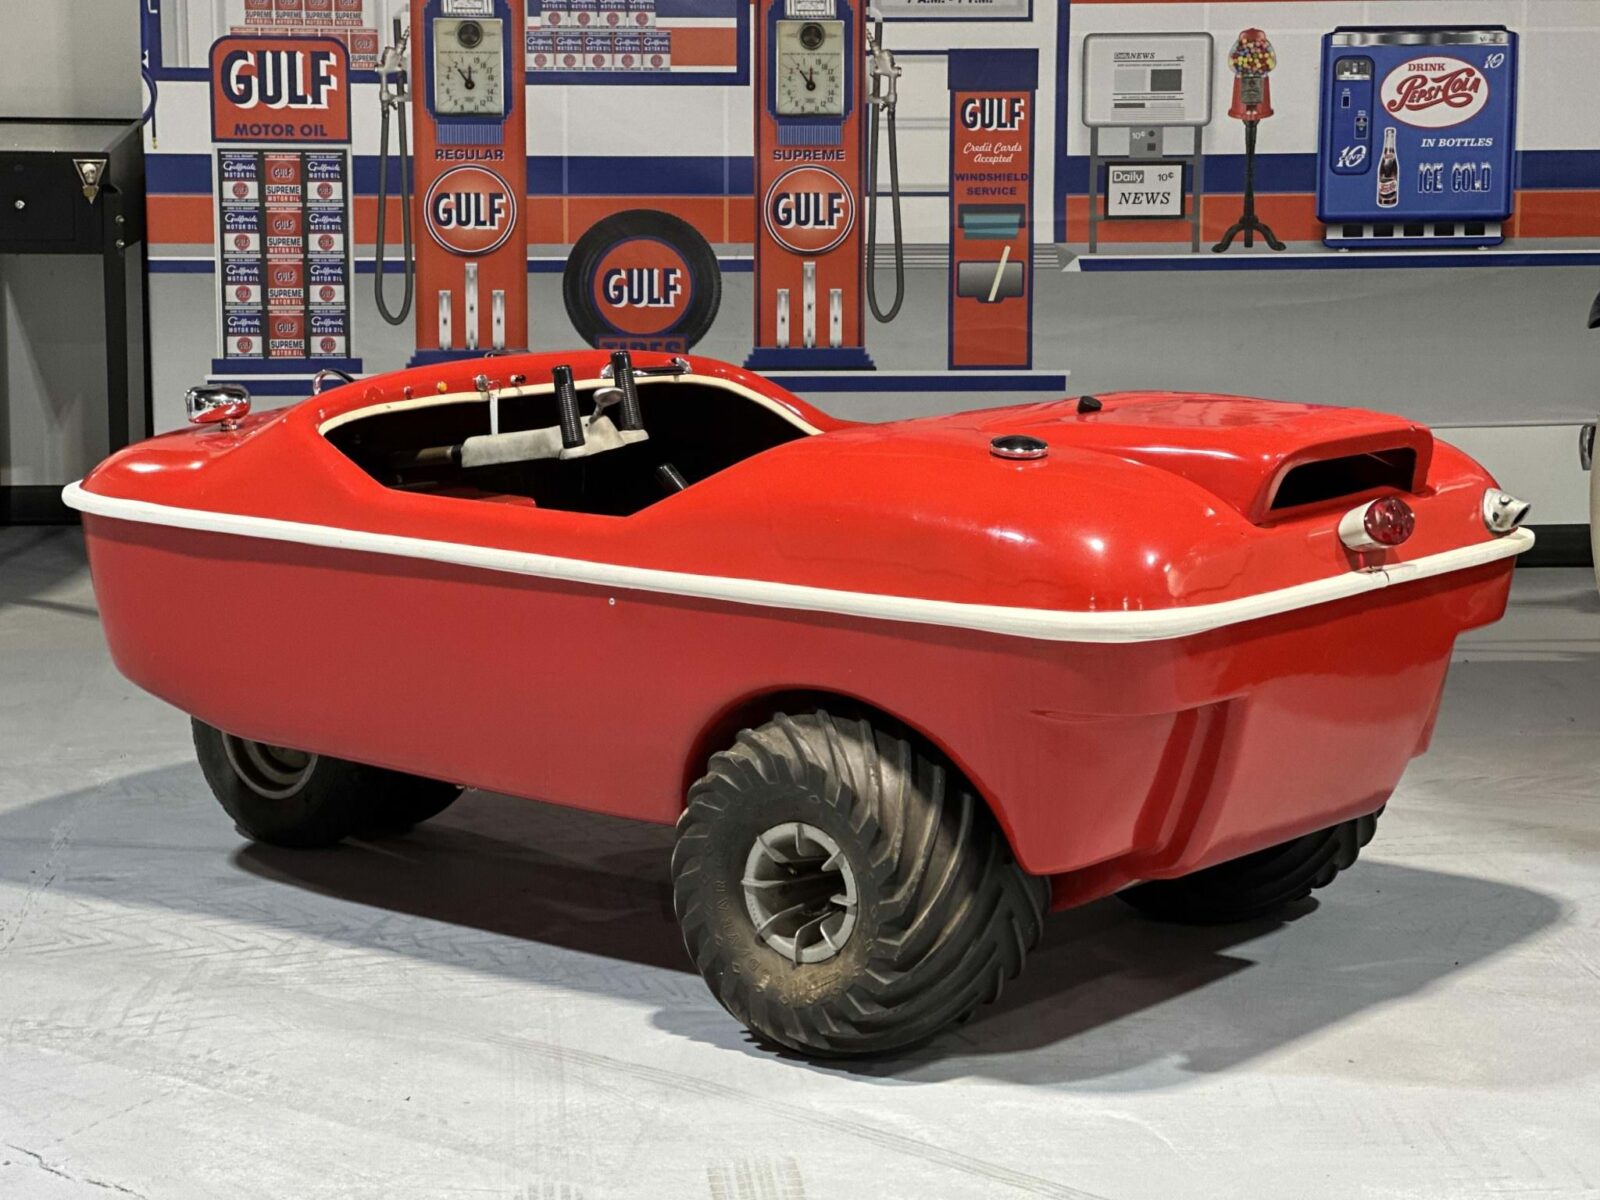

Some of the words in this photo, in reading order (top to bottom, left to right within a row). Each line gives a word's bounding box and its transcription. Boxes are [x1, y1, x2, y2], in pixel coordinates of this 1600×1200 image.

[1484, 53, 1504, 68] 10
[1408, 63, 1445, 71] DRINK
[221, 50, 337, 110] GULF
[961, 98, 1024, 131] GULF
[234, 124, 294, 137] MOTOR
[300, 124, 327, 137] OIL
[963, 142, 992, 154] Credit
[994, 142, 1022, 154] Cards
[1421, 138, 1435, 147] IN
[1438, 138, 1493, 147] BOTTLES
[435, 149, 504, 160] REGULAR
[773, 150, 845, 161] SUPREME
[974, 153, 1013, 165] Accepted
[1337, 145, 1366, 167] 10
[273, 169, 292, 178] GULF
[954, 173, 1028, 181] WINDSHIELD
[1113, 171, 1143, 183] Daily
[1158, 172, 1174, 181] 10¢
[1418, 162, 1443, 193] ICE
[1451, 162, 1491, 192] COLD
[967, 187, 1017, 195] SERVICE
[1119, 192, 1170, 205] NEWS
[434, 192, 505, 230] GULF
[773, 192, 845, 229] GULF
[275, 221, 293, 229] GULF
[269, 238, 300, 246] SUPREME
[276, 272, 294, 281] GULF
[603, 268, 681, 308] GULF
[277, 323, 295, 331] GULF
